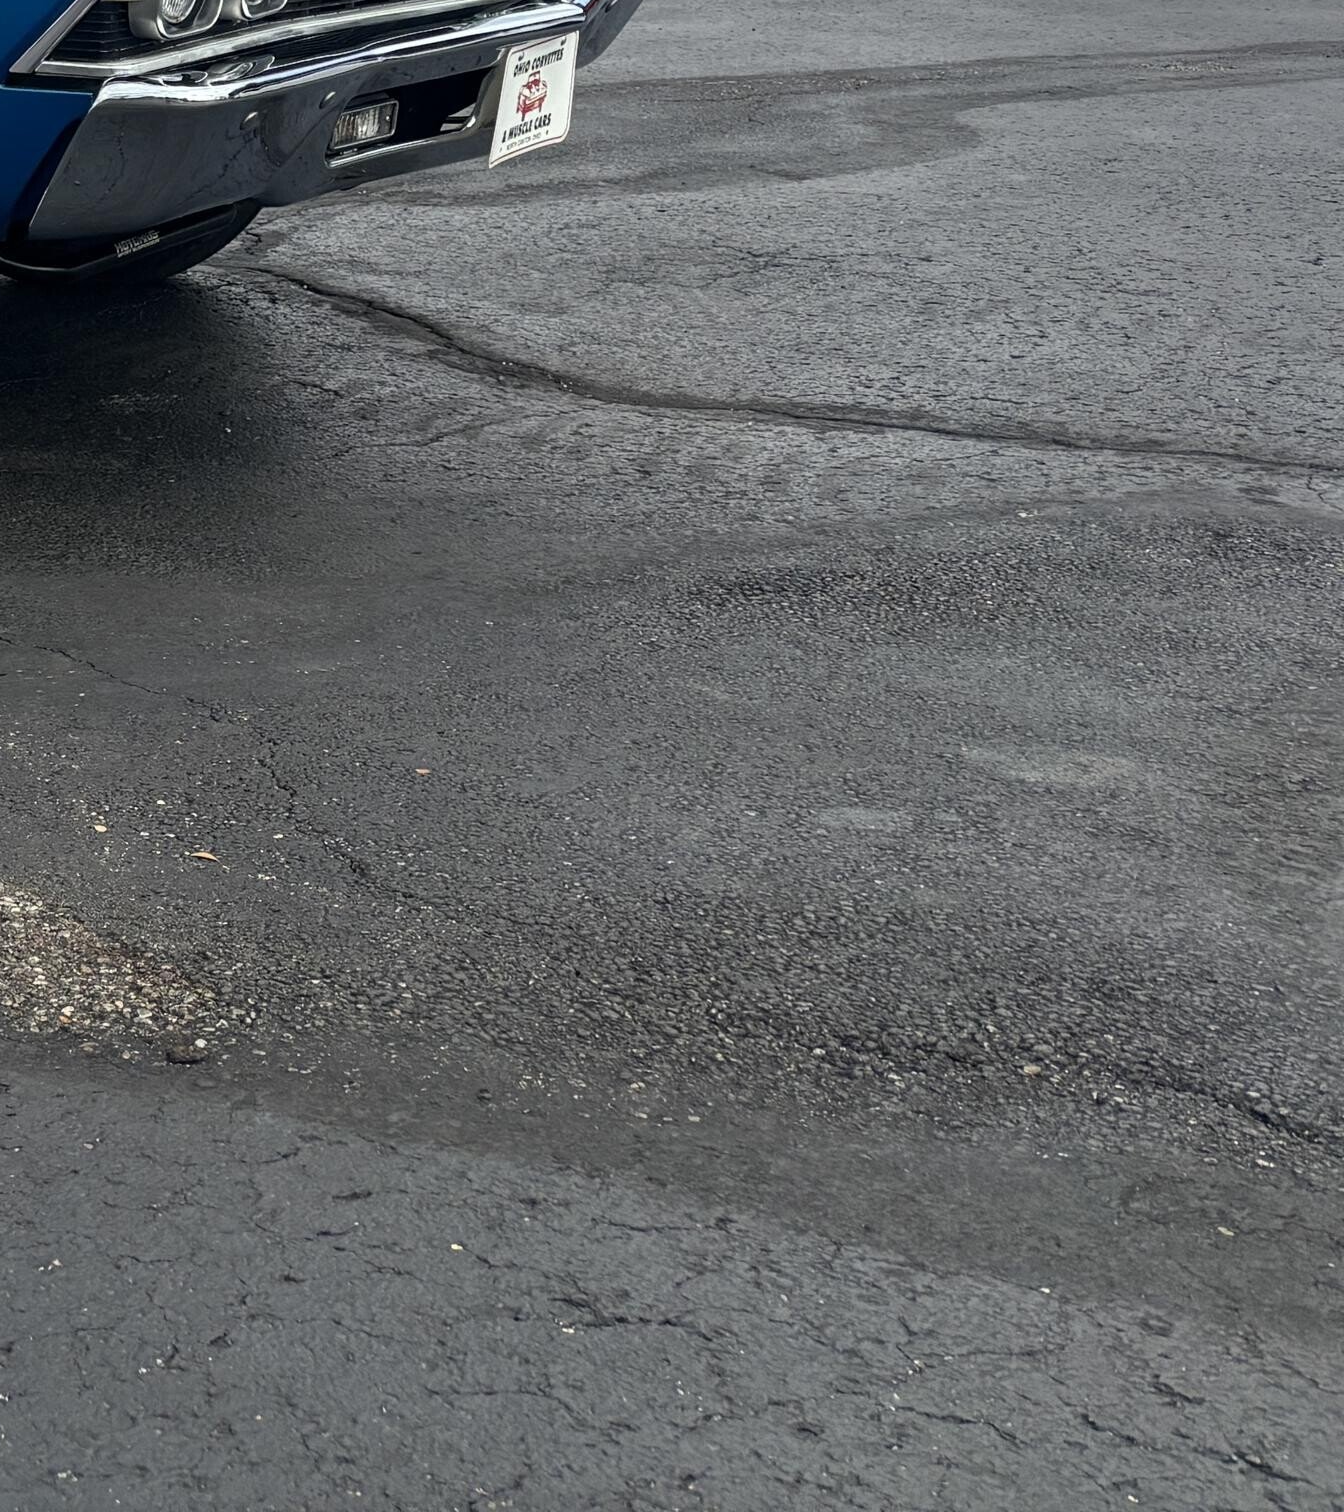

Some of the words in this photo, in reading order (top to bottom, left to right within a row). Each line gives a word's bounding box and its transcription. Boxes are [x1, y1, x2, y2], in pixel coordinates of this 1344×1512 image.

[513, 59, 531, 78] OHIO
[532, 48, 565, 71] CORVETTES
[507, 119, 533, 141] MUSCLE
[534, 113, 551, 130] CARS
